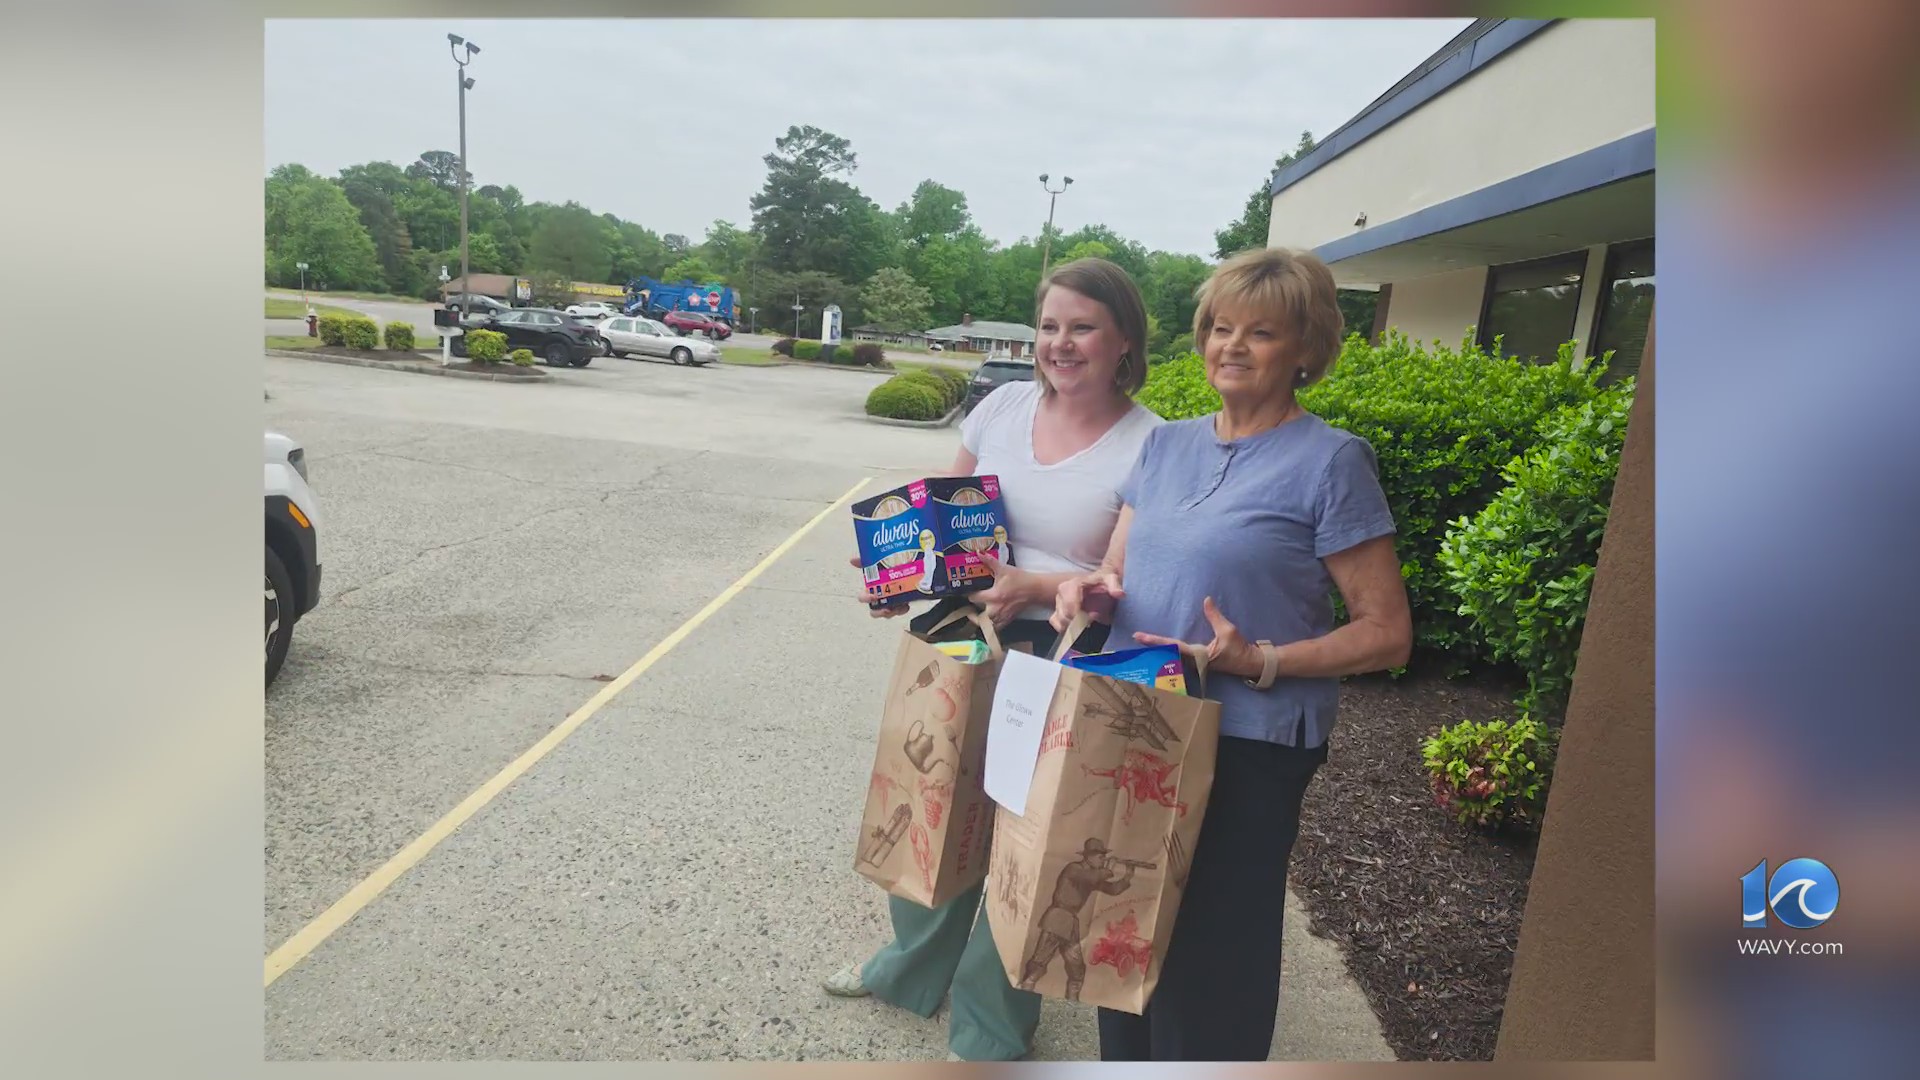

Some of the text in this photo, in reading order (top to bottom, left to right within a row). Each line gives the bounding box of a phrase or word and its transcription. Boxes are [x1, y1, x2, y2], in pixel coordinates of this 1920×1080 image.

[910, 490, 926, 501] 30%
[951, 509, 994, 532] always
[873, 518, 919, 547] always
[880, 544, 894, 553] ULTRA
[885, 583, 891, 593] 4
[956, 802, 979, 875] TRADER
